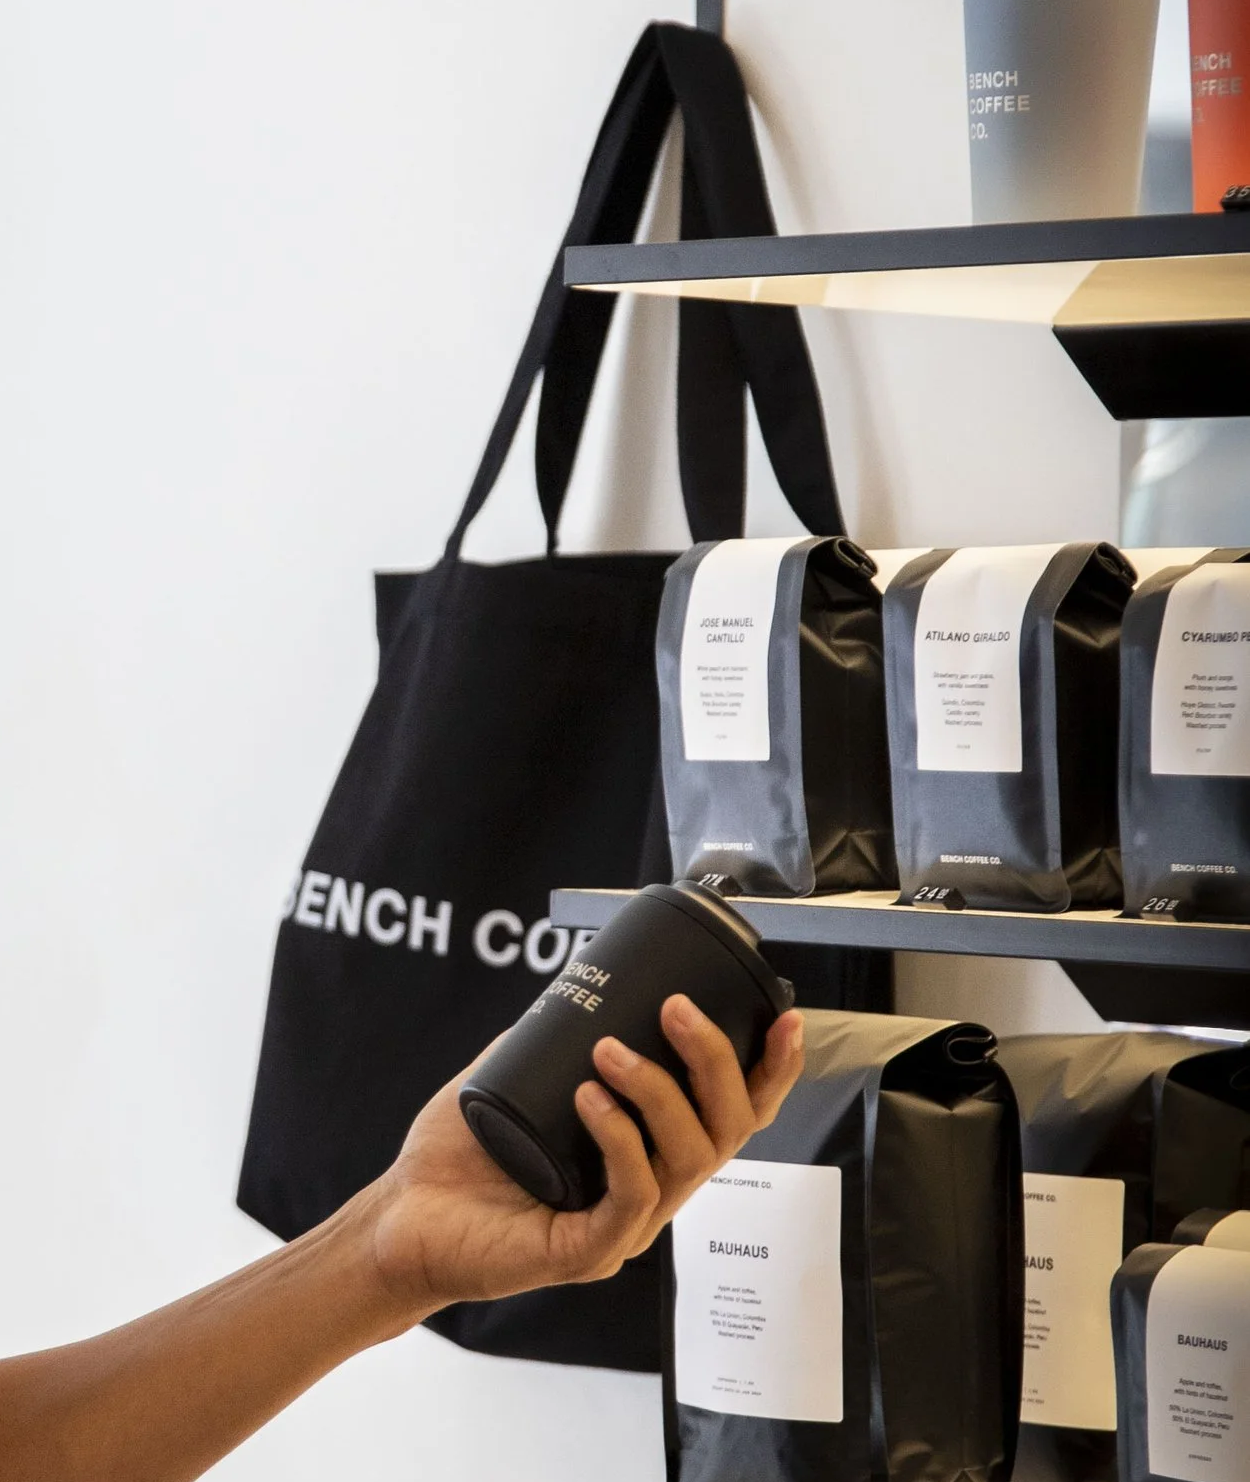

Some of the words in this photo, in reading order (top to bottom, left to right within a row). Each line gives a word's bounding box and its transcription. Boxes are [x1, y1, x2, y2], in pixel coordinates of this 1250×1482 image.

[969, 71, 1018, 89] BENCH
[970, 94, 1031, 115] COFFEE
[970, 123, 988, 140] CO.
[722, 617, 754, 627] MANUEL
[707, 633, 745, 643] CANTILLO
[925, 631, 970, 643] ATILANO
[973, 631, 1010, 643] GIRALDO
[1182, 631, 1238, 643] CYARUMBO
[940, 855, 963, 863] BENCH
[964, 855, 989, 864] COFFEE
[990, 856, 1002, 865] CO.
[1171, 863, 1196, 872] BENCH
[1196, 864, 1224, 873] COFFEE
[914, 887, 939, 899] 24
[1142, 897, 1168, 911] 26
[734, 1179, 759, 1188] COFFEE
[761, 1181, 773, 1190] CO.
[1046, 1194, 1056, 1203] CO.
[710, 1241, 769, 1259] BAUHAUS
[1025, 1256, 1054, 1271] HAUS
[1177, 1334, 1228, 1351] BAUHAUS
